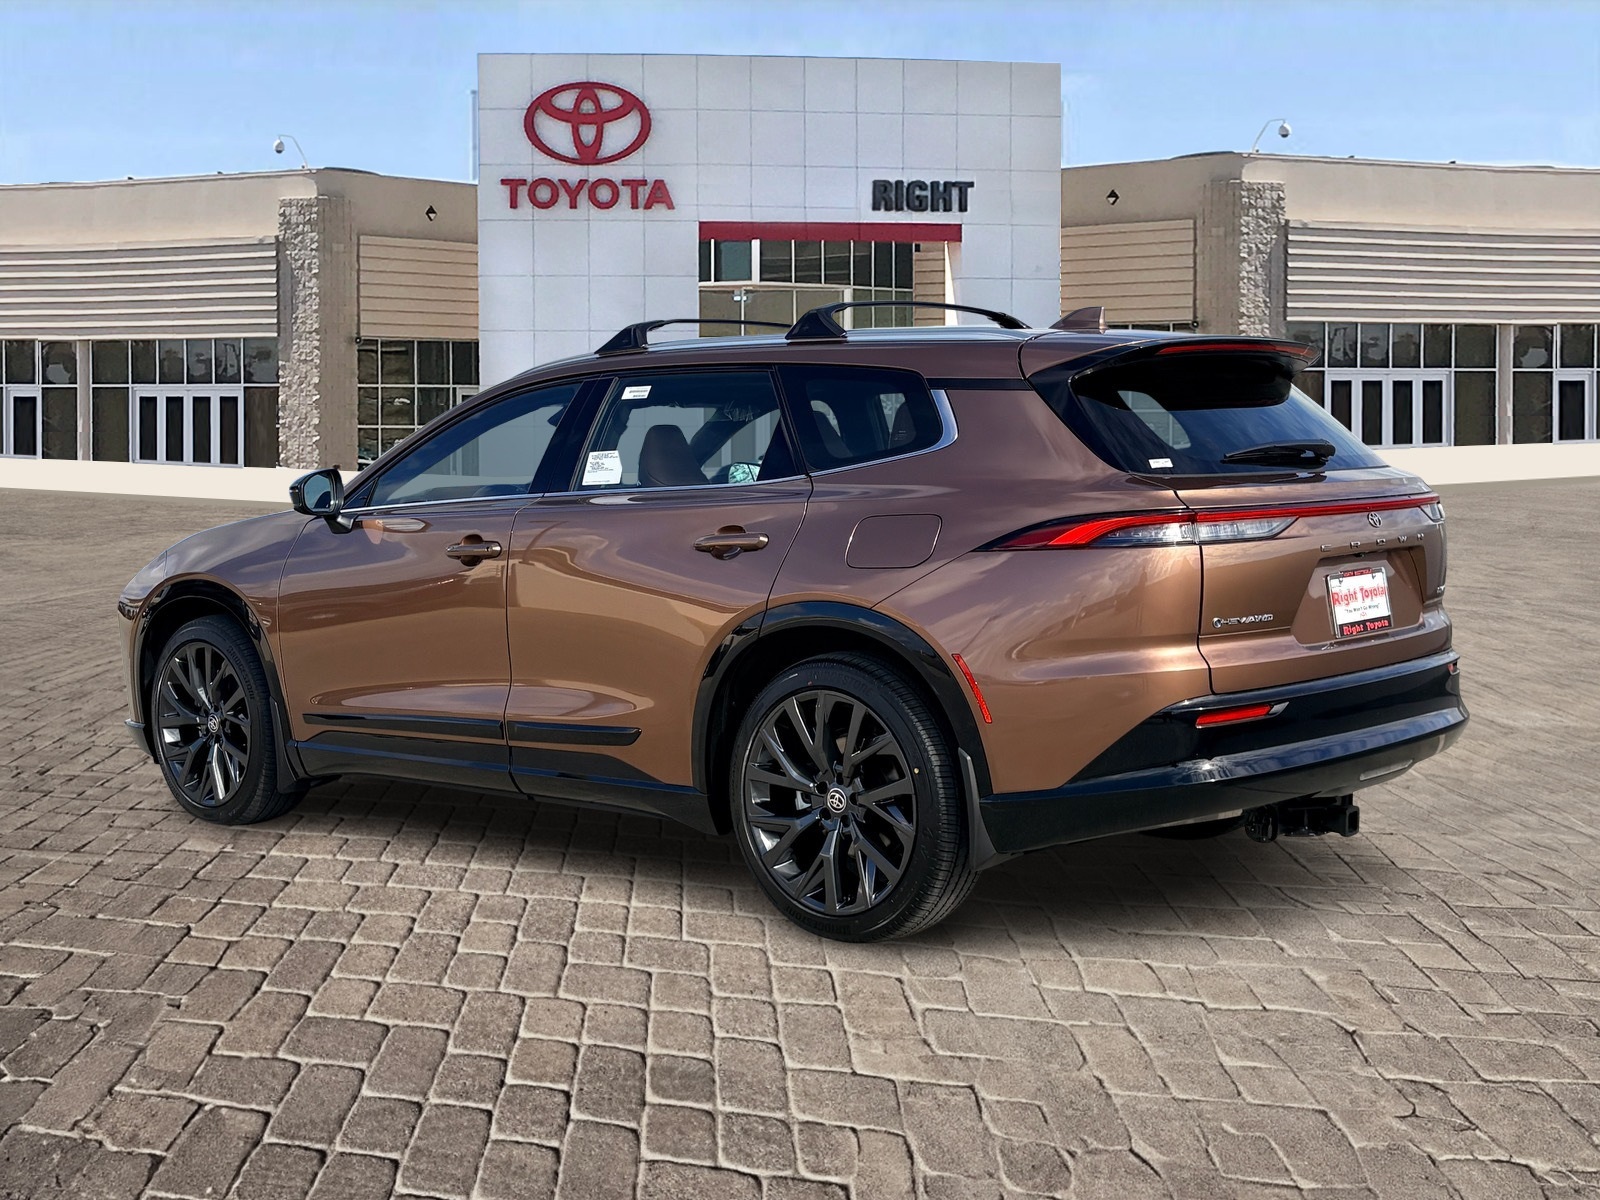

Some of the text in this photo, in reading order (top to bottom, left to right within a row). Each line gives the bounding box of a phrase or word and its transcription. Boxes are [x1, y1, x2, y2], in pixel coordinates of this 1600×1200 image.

[500, 178, 675, 210] TOYOTA
[872, 179, 975, 212] RIGHT
[1321, 532, 1425, 552] CROWN
[1332, 585, 1386, 606] Right Toyota
[1343, 619, 1389, 636] Right Toyota
